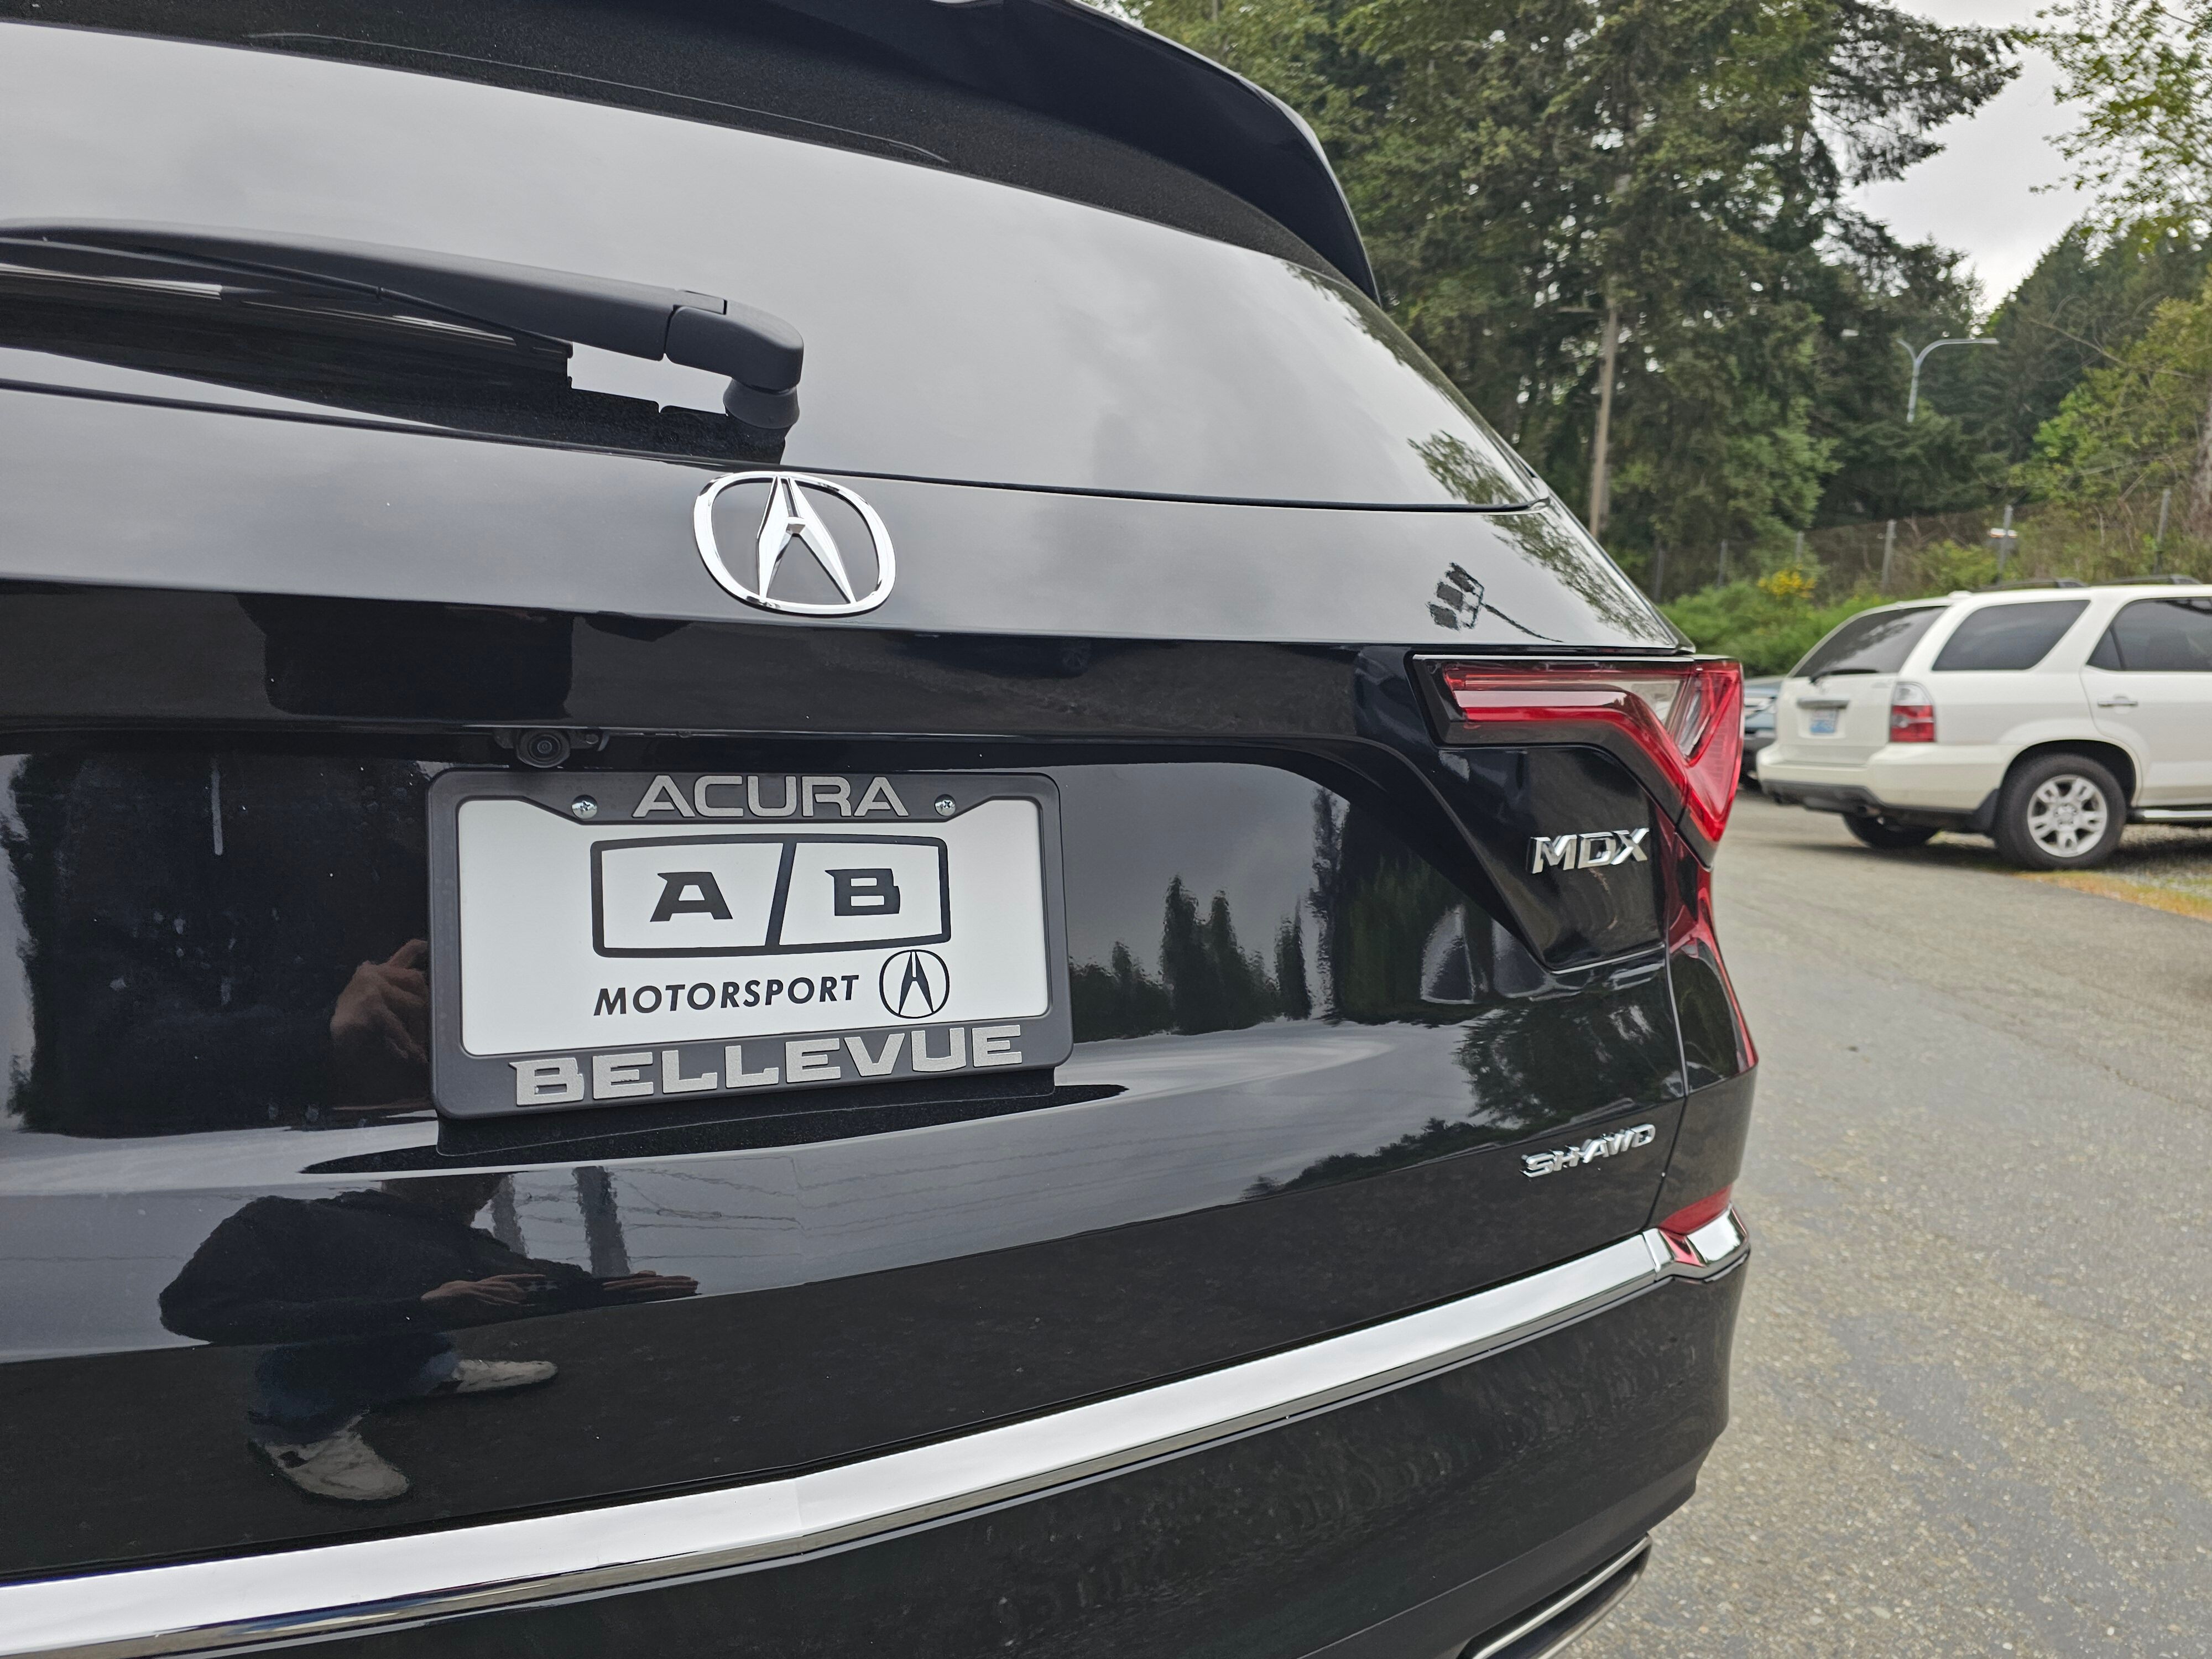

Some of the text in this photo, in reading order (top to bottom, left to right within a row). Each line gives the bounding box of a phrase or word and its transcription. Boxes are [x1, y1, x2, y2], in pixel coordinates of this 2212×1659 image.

[632, 775, 909, 817] ACURA
[1526, 828, 1650, 874] MDX
[650, 868, 901, 922] A B
[593, 974, 859, 1016] MOTORSPORT
[508, 1024, 1023, 1106] BELLEVUE
